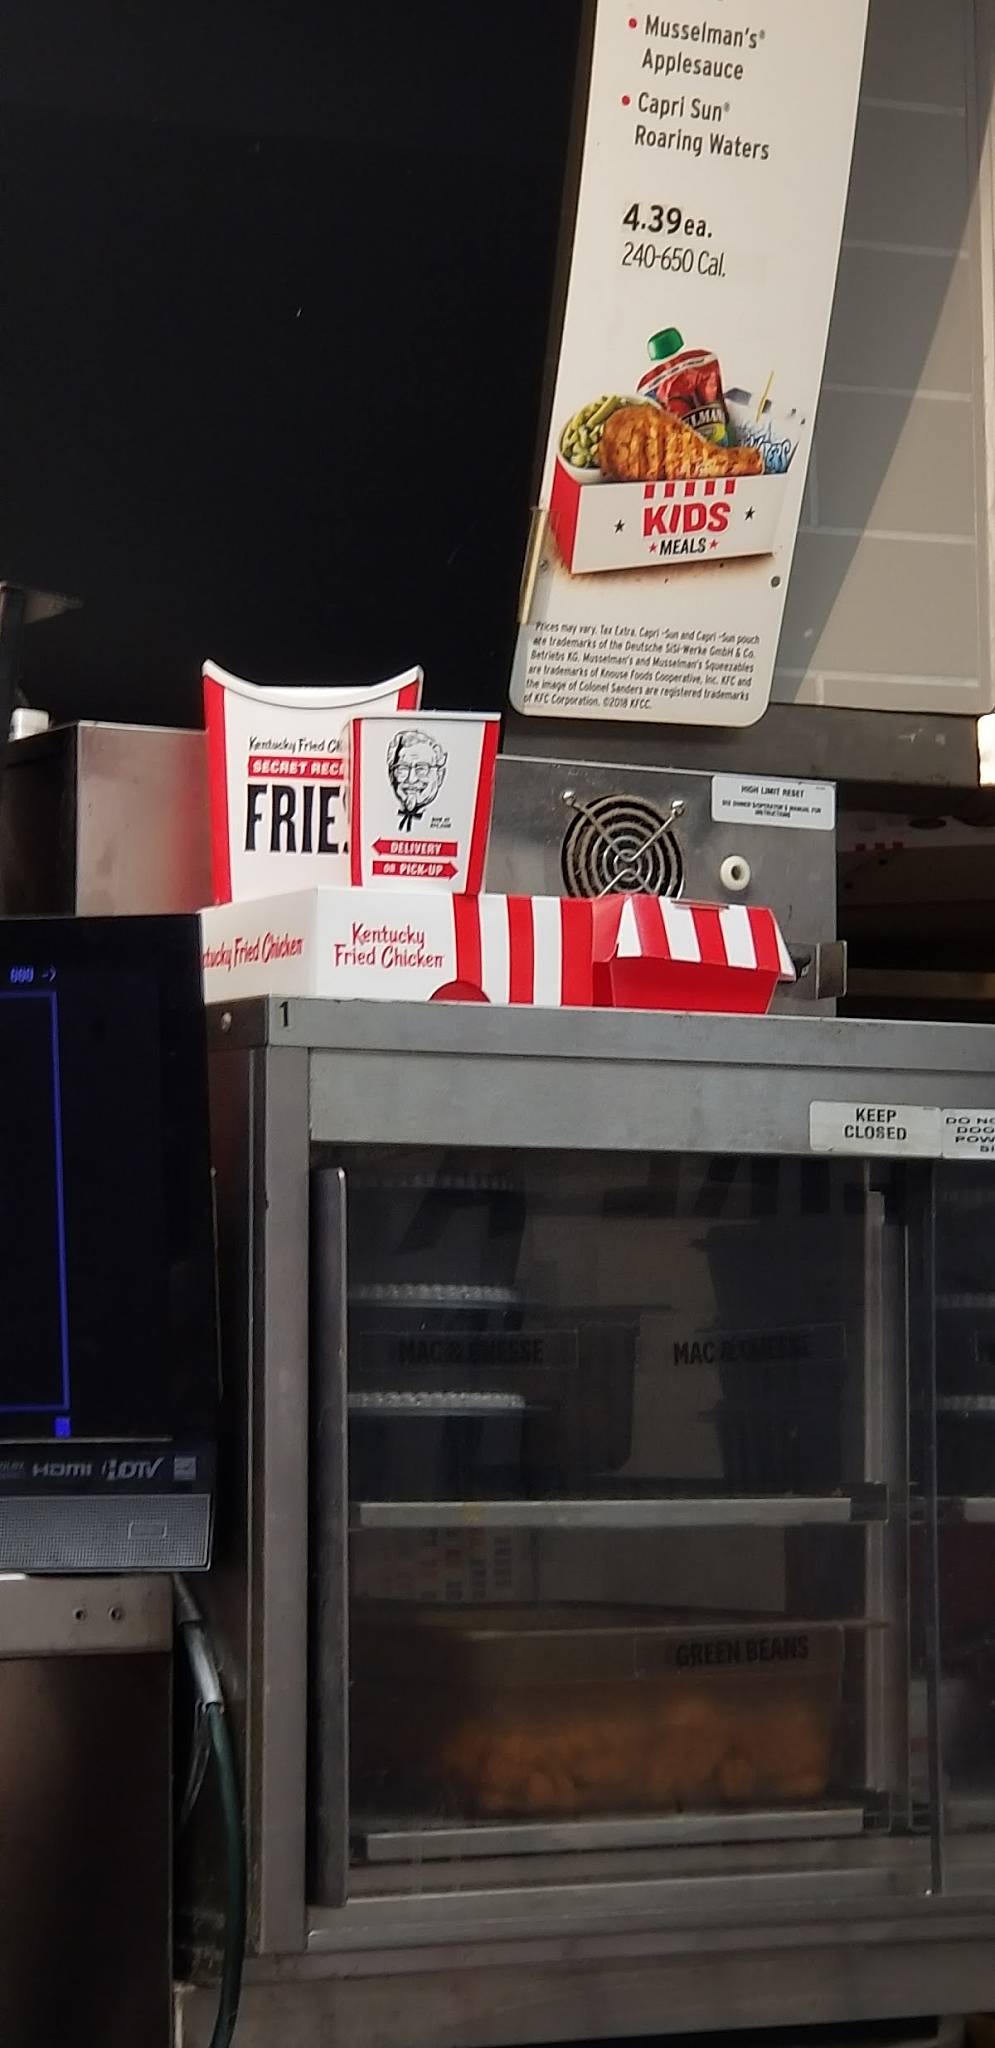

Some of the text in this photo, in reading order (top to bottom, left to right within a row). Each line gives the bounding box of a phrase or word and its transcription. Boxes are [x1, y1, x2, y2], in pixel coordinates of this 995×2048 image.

[642, 48, 744, 80] Applesauce
[638, 92, 685, 119] Capri
[634, 124, 770, 160] Roaring Waters
[622, 241, 727, 277] 240-650 Cal.
[643, 501, 731, 537] KIDS
[659, 537, 707, 556] MEALS
[549, 636, 596, 648] trademarks
[543, 665, 588, 677] trademarks
[721, 675, 736, 686] KFC
[534, 693, 549, 704] KFC
[579, 681, 609, 692] Colonel
[610, 683, 643, 695] Sanders
[704, 688, 749, 701] trademarks
[248, 736, 296, 754] Kentucky
[297, 738, 325, 752] Fried
[252, 759, 309, 775] SECRET
[761, 787, 780, 796] LIMIT
[782, 788, 804, 798] RESET
[390, 841, 442, 855] DELIVERY
[400, 863, 444, 876] PICK-UP
[352, 921, 425, 950] Kentucky
[234, 937, 261, 968] Fried
[262, 932, 304, 963] Chicken
[334, 944, 444, 969] Fried Chicken
[280, 1001, 289, 1027] 1
[856, 1107, 897, 1123] KEEP
[946, 1117, 995, 1125] DO NO
[844, 1125, 907, 1141] CLOSED
[957, 1126, 995, 1134] DOO
[673, 1341, 715, 1366] MAC
[32, 1462, 92, 1479] HDMI
[675, 1634, 809, 1667] GREEN BEANS
